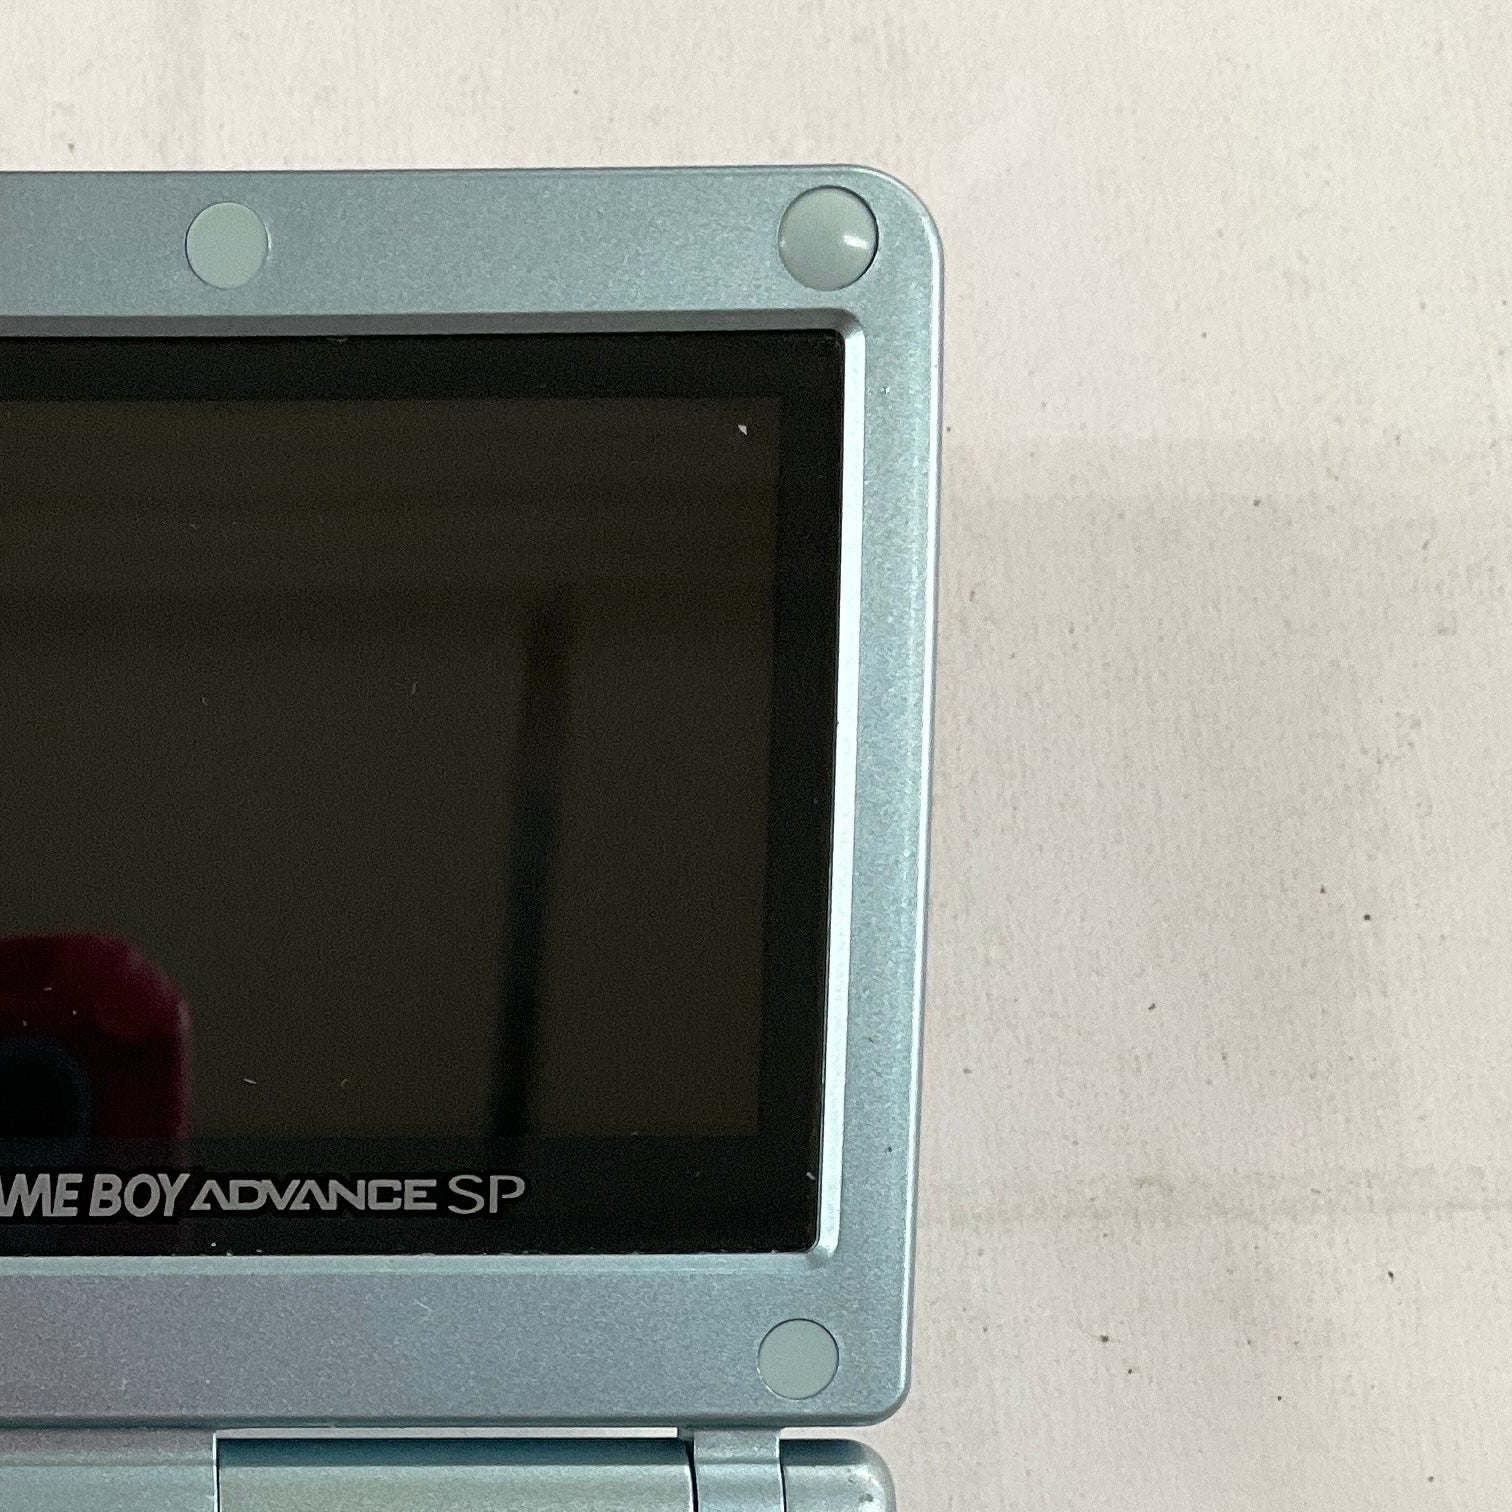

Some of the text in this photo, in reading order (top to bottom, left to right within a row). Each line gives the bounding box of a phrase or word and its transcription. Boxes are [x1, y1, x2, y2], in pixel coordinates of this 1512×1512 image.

[88, 1172, 190, 1218] BOY
[190, 1178, 438, 1212] ADVANCE
[447, 1173, 527, 1215] SP
